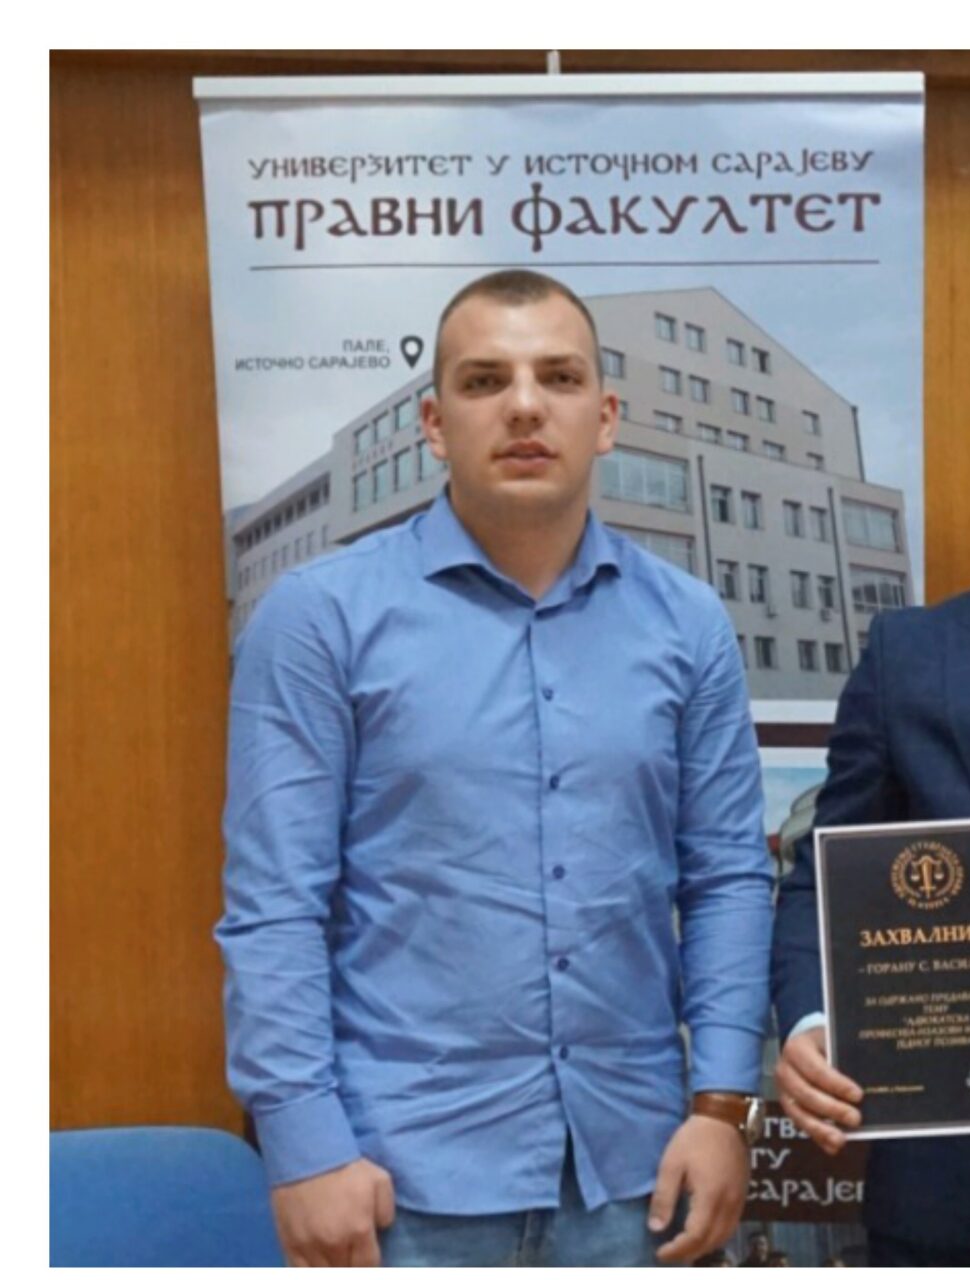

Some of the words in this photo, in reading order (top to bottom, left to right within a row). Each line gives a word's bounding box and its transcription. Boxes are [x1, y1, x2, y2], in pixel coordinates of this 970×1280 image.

[248, 154, 472, 184] УНИВЕРЗИТЕТ
[487, 154, 511, 178] У
[523, 152, 699, 182] ИСТОЧНОМ
[711, 149, 875, 178] САРАЈЕВУ
[248, 196, 484, 251] ПРАВНИ
[511, 182, 881, 253] ФАКУЛТЕТ
[235, 357, 304, 371] ИСТОЧНО
[308, 356, 390, 369] САРАЈЕВО
